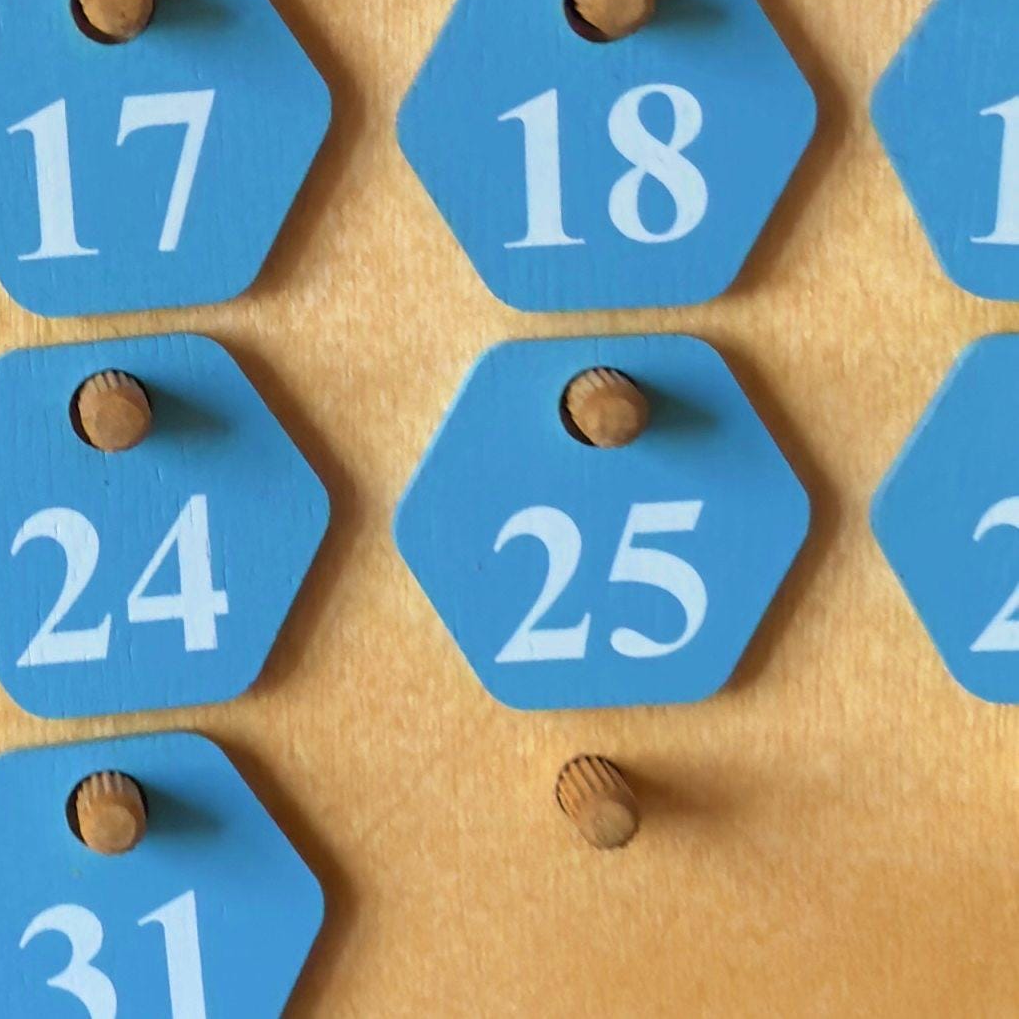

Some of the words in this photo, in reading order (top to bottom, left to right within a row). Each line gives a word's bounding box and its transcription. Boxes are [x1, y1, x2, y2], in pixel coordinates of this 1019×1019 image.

[7, 88, 215, 260] 17
[497, 83, 708, 248] 18
[11, 493, 230, 667] 24
[494, 499, 707, 663] 25
[19, 889, 207, 1019] 31
